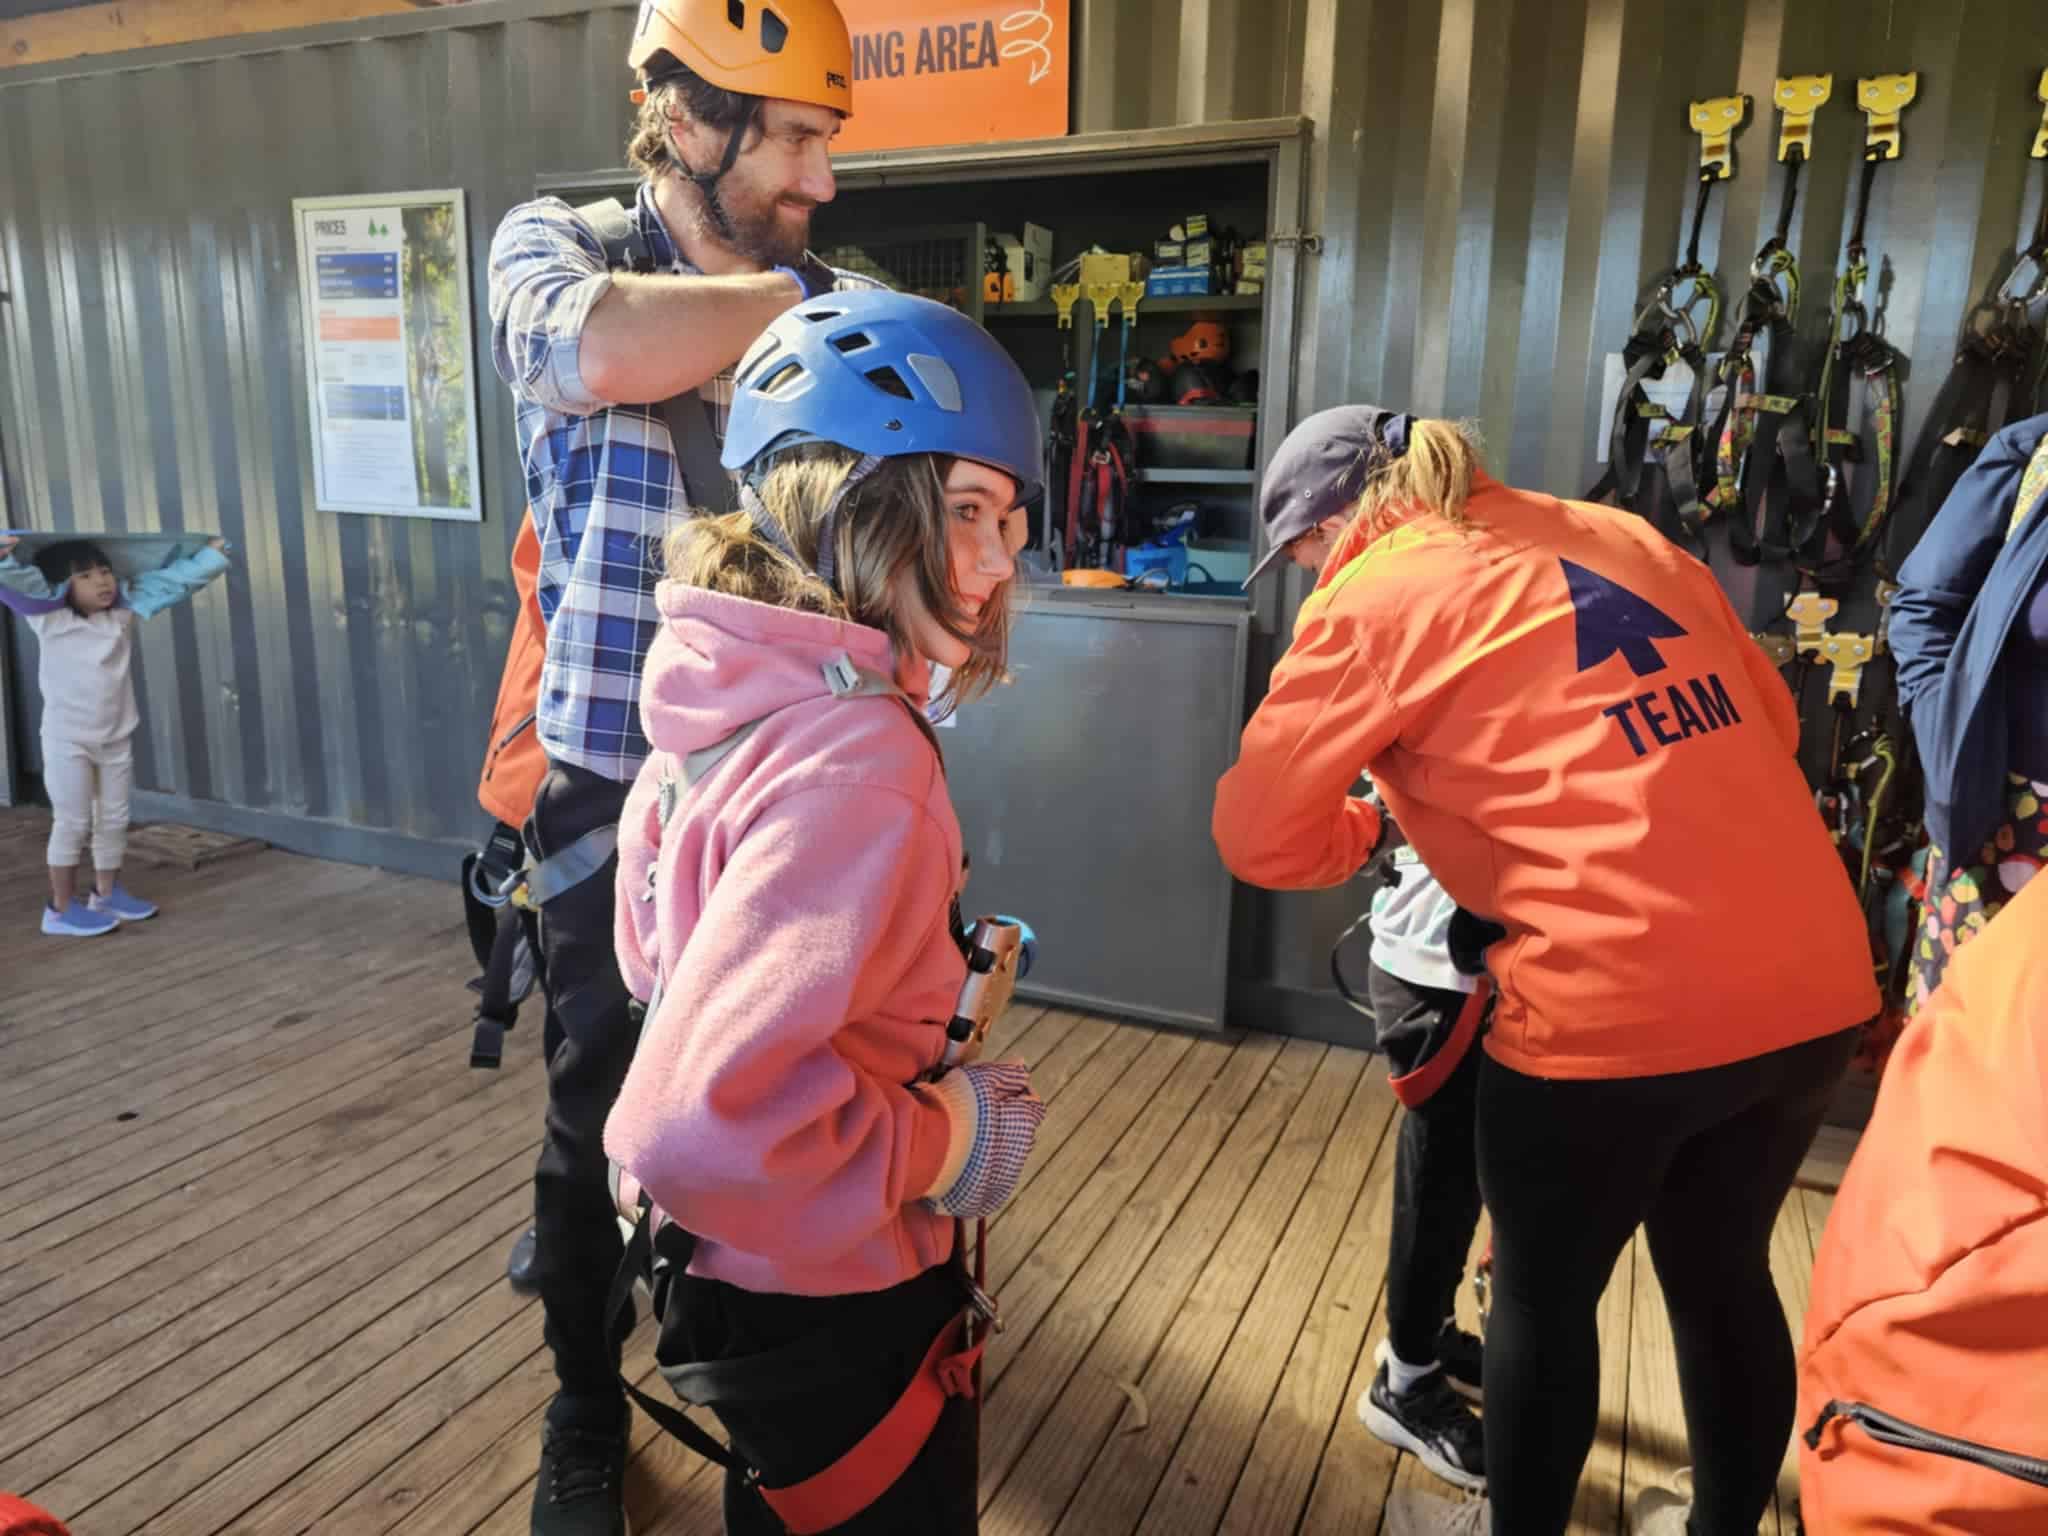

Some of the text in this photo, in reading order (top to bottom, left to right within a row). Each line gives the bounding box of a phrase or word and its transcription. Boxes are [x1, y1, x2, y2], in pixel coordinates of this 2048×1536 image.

[853, 20, 999, 80] ING AREA
[315, 219, 346, 236] PRICES
[1603, 673, 1742, 757] TEAM
